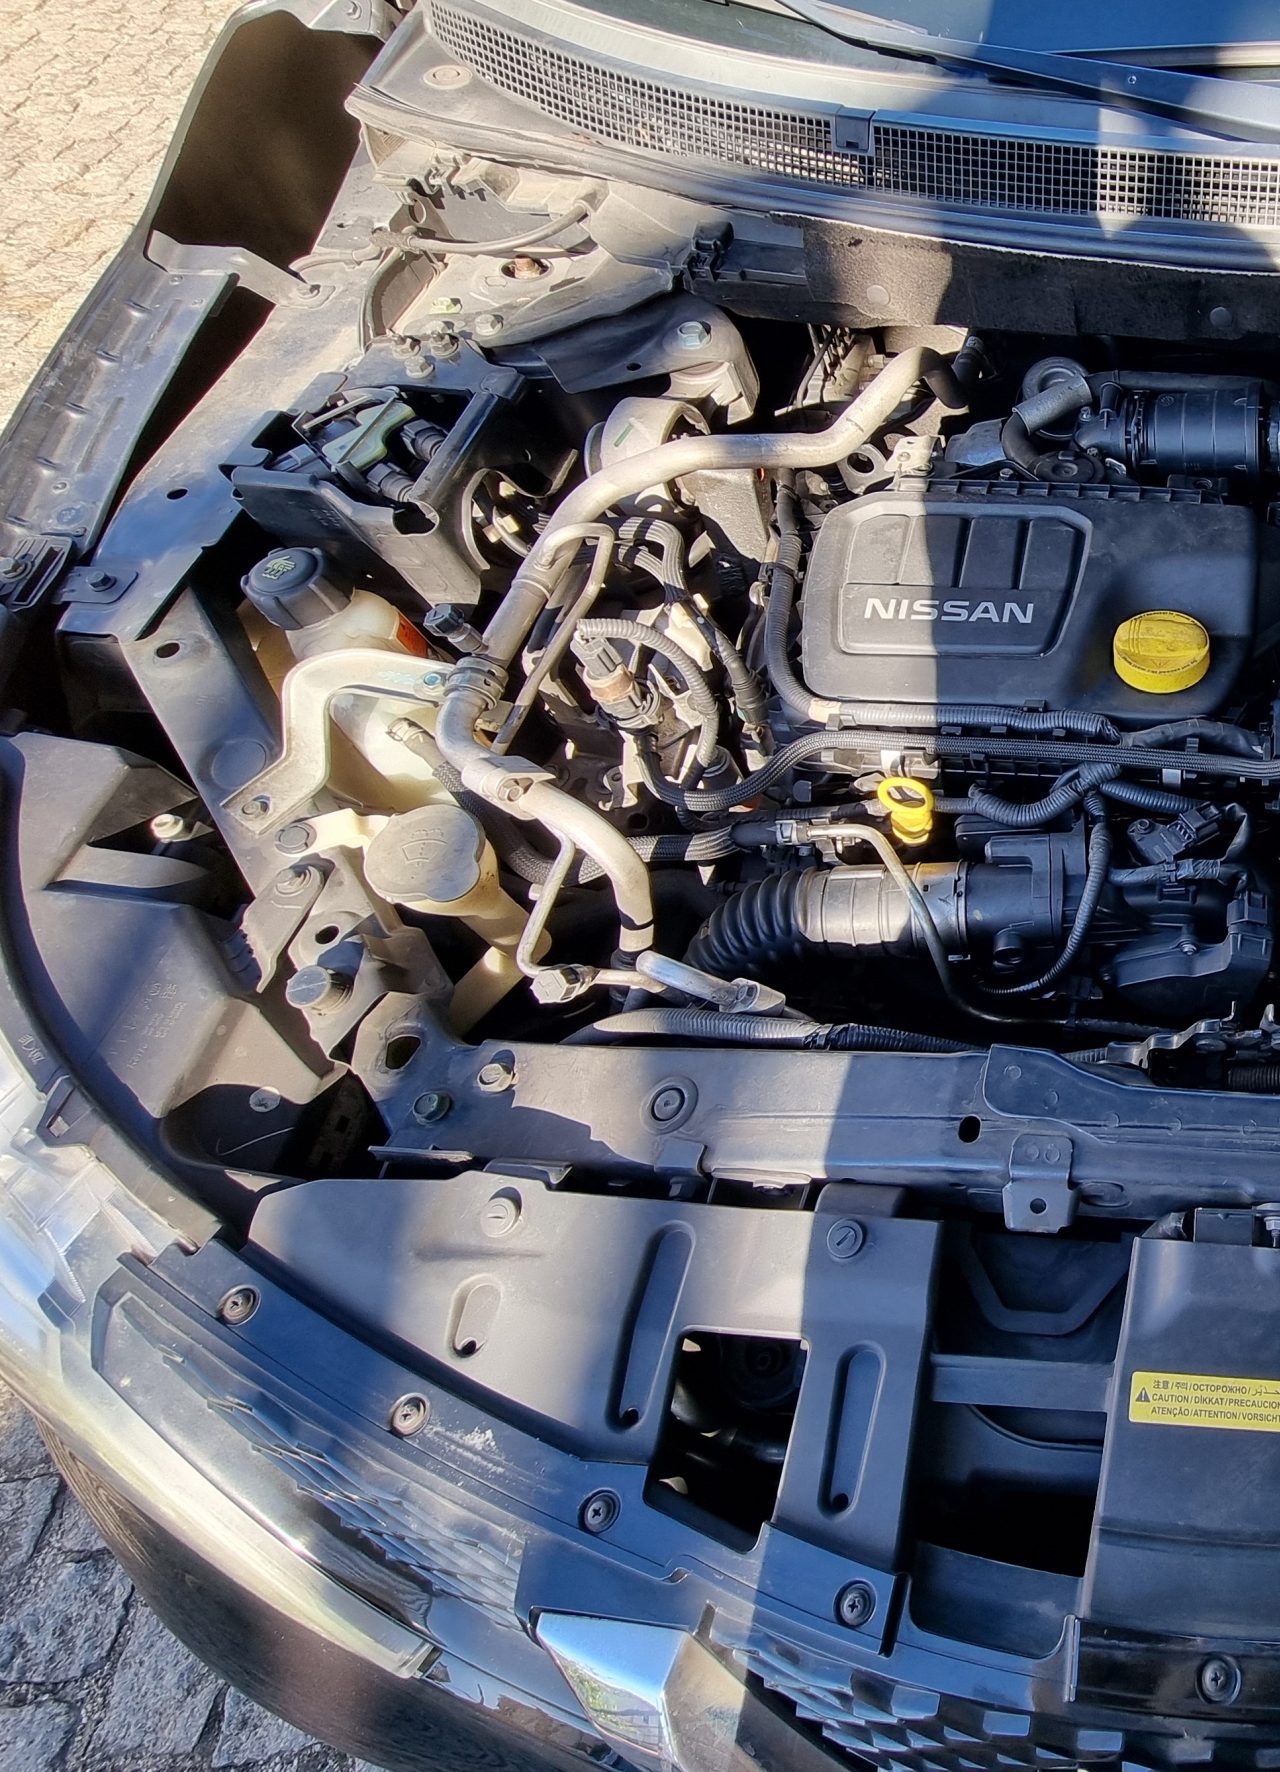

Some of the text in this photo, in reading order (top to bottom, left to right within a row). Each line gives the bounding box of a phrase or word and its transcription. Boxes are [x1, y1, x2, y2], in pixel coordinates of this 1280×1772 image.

[864, 598, 1034, 624] NISSAN
[1193, 1383, 1247, 1395] ОСТОРОЖНО
[1152, 1393, 1189, 1404] CAUTION
[1151, 1406, 1190, 1417] ATENÇÃO
[1193, 1409, 1238, 1420] ATTENTION
